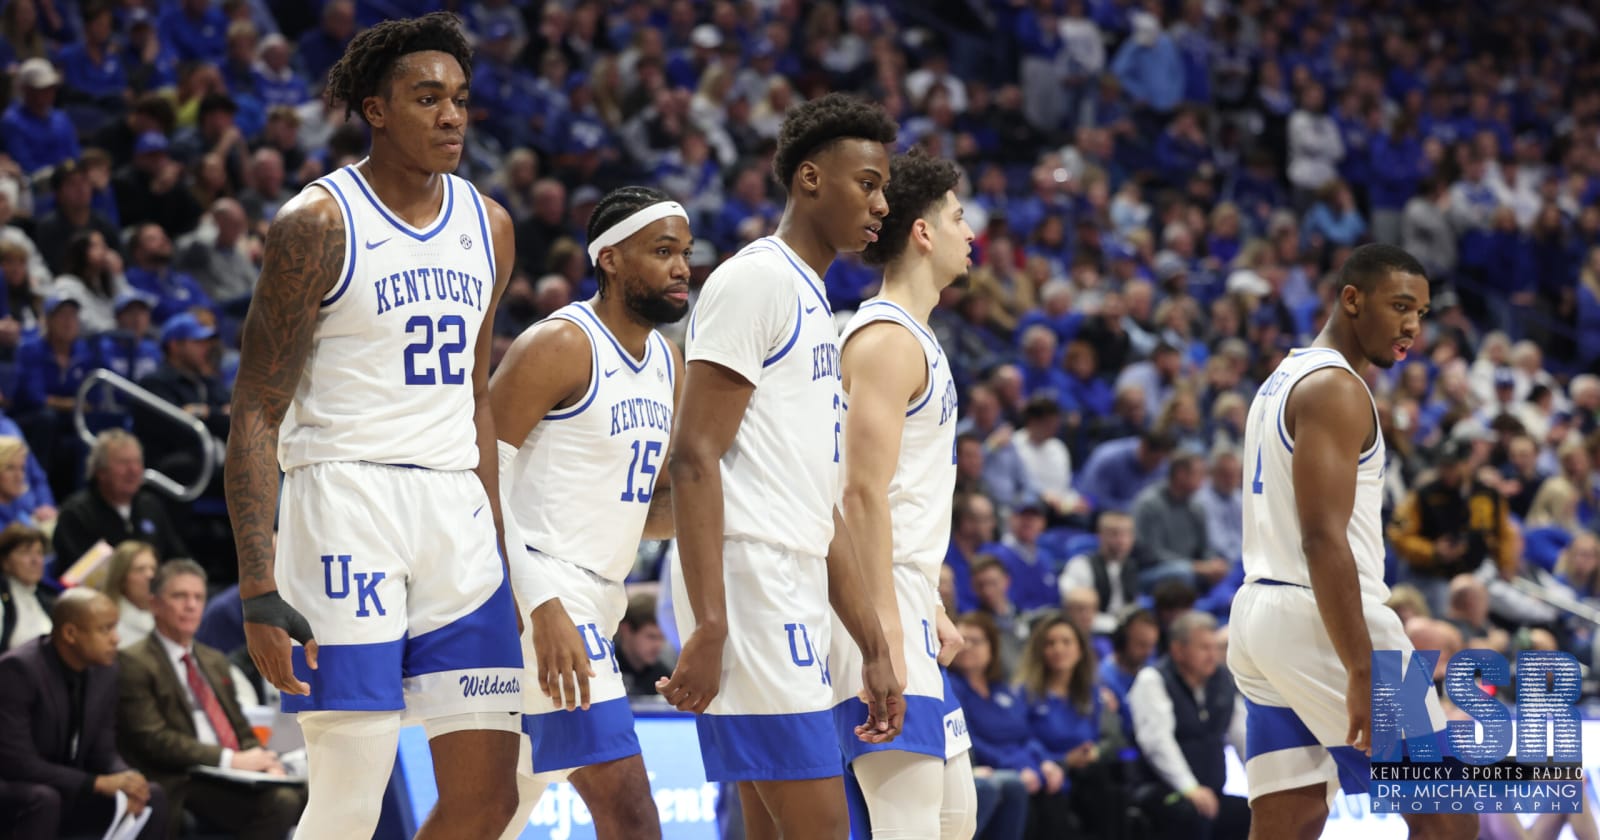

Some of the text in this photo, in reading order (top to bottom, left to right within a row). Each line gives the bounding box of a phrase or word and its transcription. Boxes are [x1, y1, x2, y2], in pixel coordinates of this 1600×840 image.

[374, 268, 483, 315] KENTUCKY
[403, 314, 467, 385] 22
[812, 343, 842, 381] KENTU
[620, 440, 662, 503] 15
[321, 555, 386, 617] UK
[459, 675, 520, 697] Wildcats
